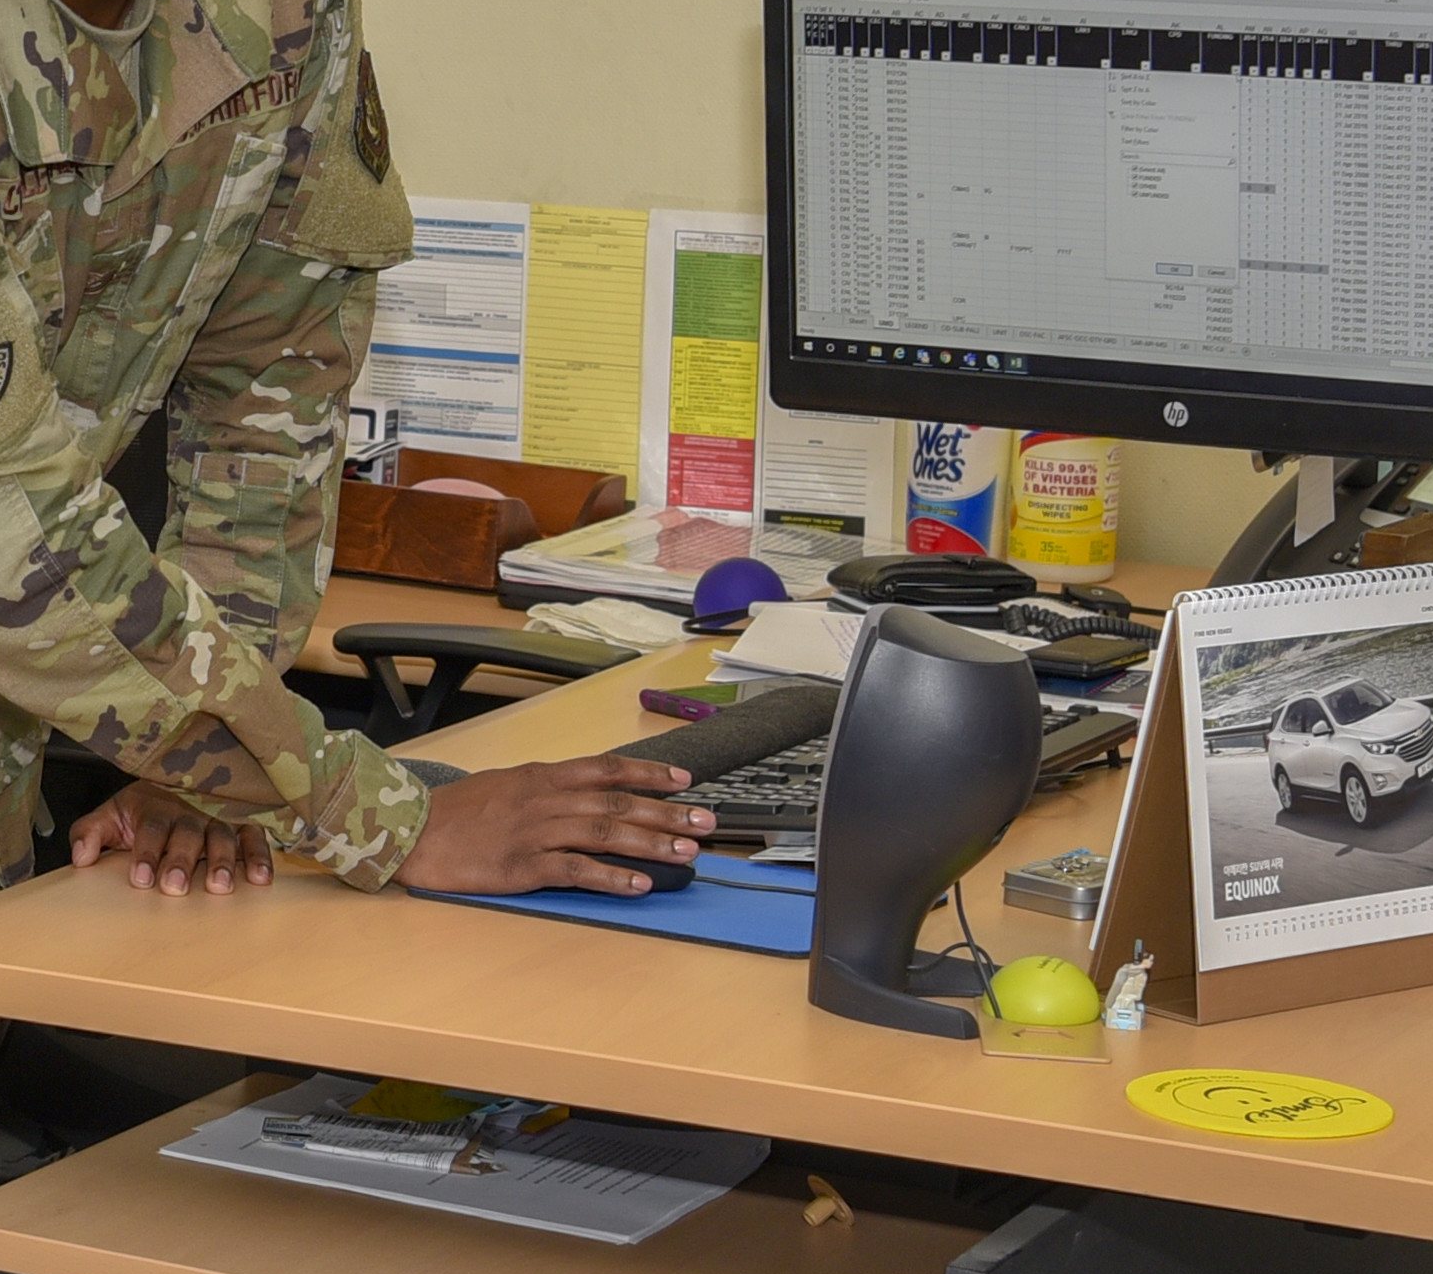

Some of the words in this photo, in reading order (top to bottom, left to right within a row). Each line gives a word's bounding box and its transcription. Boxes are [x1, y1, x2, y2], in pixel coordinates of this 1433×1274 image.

[1166, 402, 1186, 427] hp
[917, 423, 971, 456] Wet
[913, 451, 965, 483] Ones
[1024, 459, 1054, 472] KILLS
[1058, 463, 1098, 474] 99.9%
[1023, 471, 1037, 481] OF
[1041, 474, 1097, 485] VIRUSES
[1033, 484, 1096, 497] BACTERIA
[1028, 501, 1089, 512] DISINFECTING
[1042, 511, 1071, 519] WIPES
[1224, 875, 1280, 901] EQUINOX
